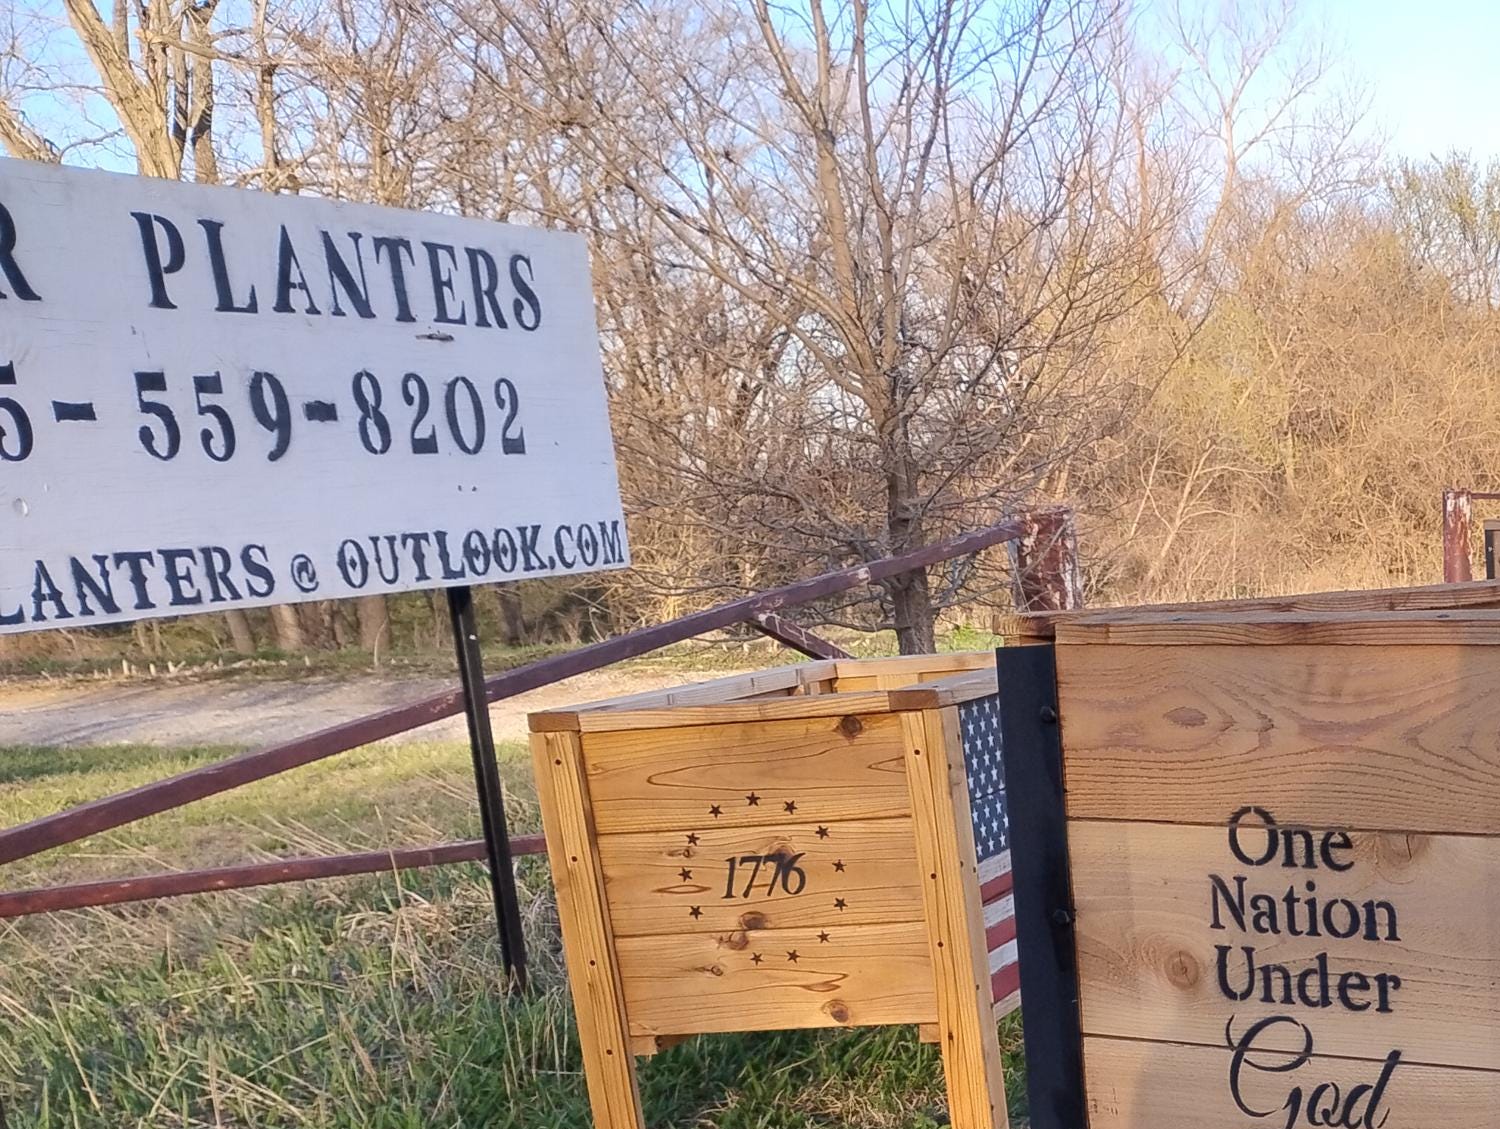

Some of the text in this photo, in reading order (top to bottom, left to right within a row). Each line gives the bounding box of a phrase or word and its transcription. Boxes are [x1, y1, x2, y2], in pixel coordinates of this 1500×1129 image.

[130, 211, 541, 332] PLANTERS
[1227, 806, 1355, 873] One
[721, 852, 807, 899] 1776
[1208, 874, 1402, 942] Nation
[1215, 944, 1402, 1013] Under
